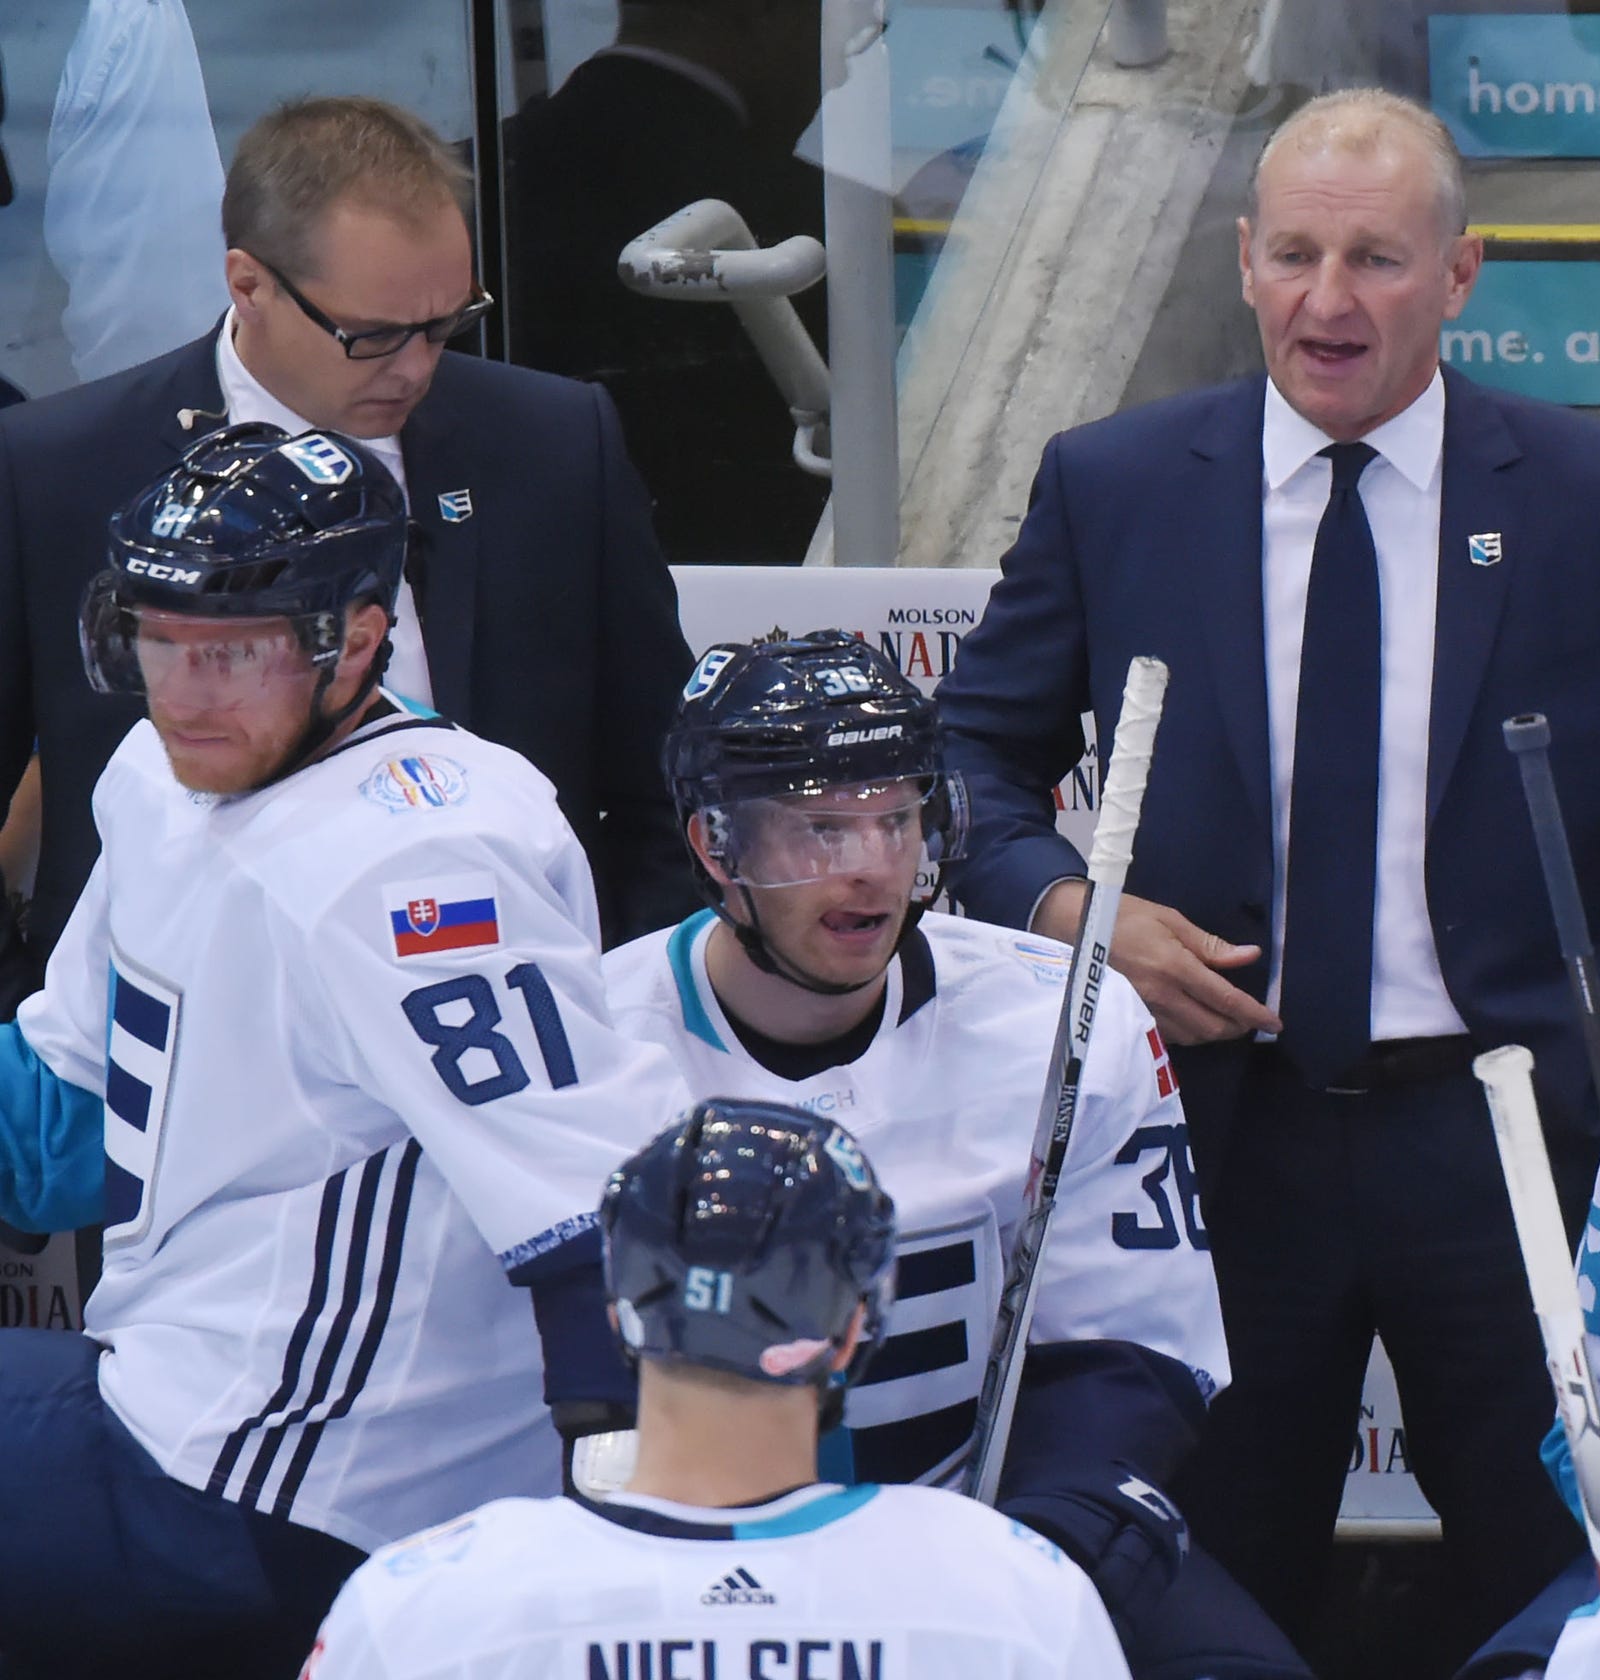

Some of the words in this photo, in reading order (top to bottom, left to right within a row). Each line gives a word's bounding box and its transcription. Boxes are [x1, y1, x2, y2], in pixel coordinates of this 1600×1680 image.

[126, 557, 201, 585] CCM
[888, 609, 975, 625] MOLSON
[815, 666, 872, 697] 36
[828, 725, 903, 747] BAUER
[401, 962, 578, 1106] 81
[1053, 1084, 1077, 1144] HANSEN
[685, 1265, 733, 1314] 51
